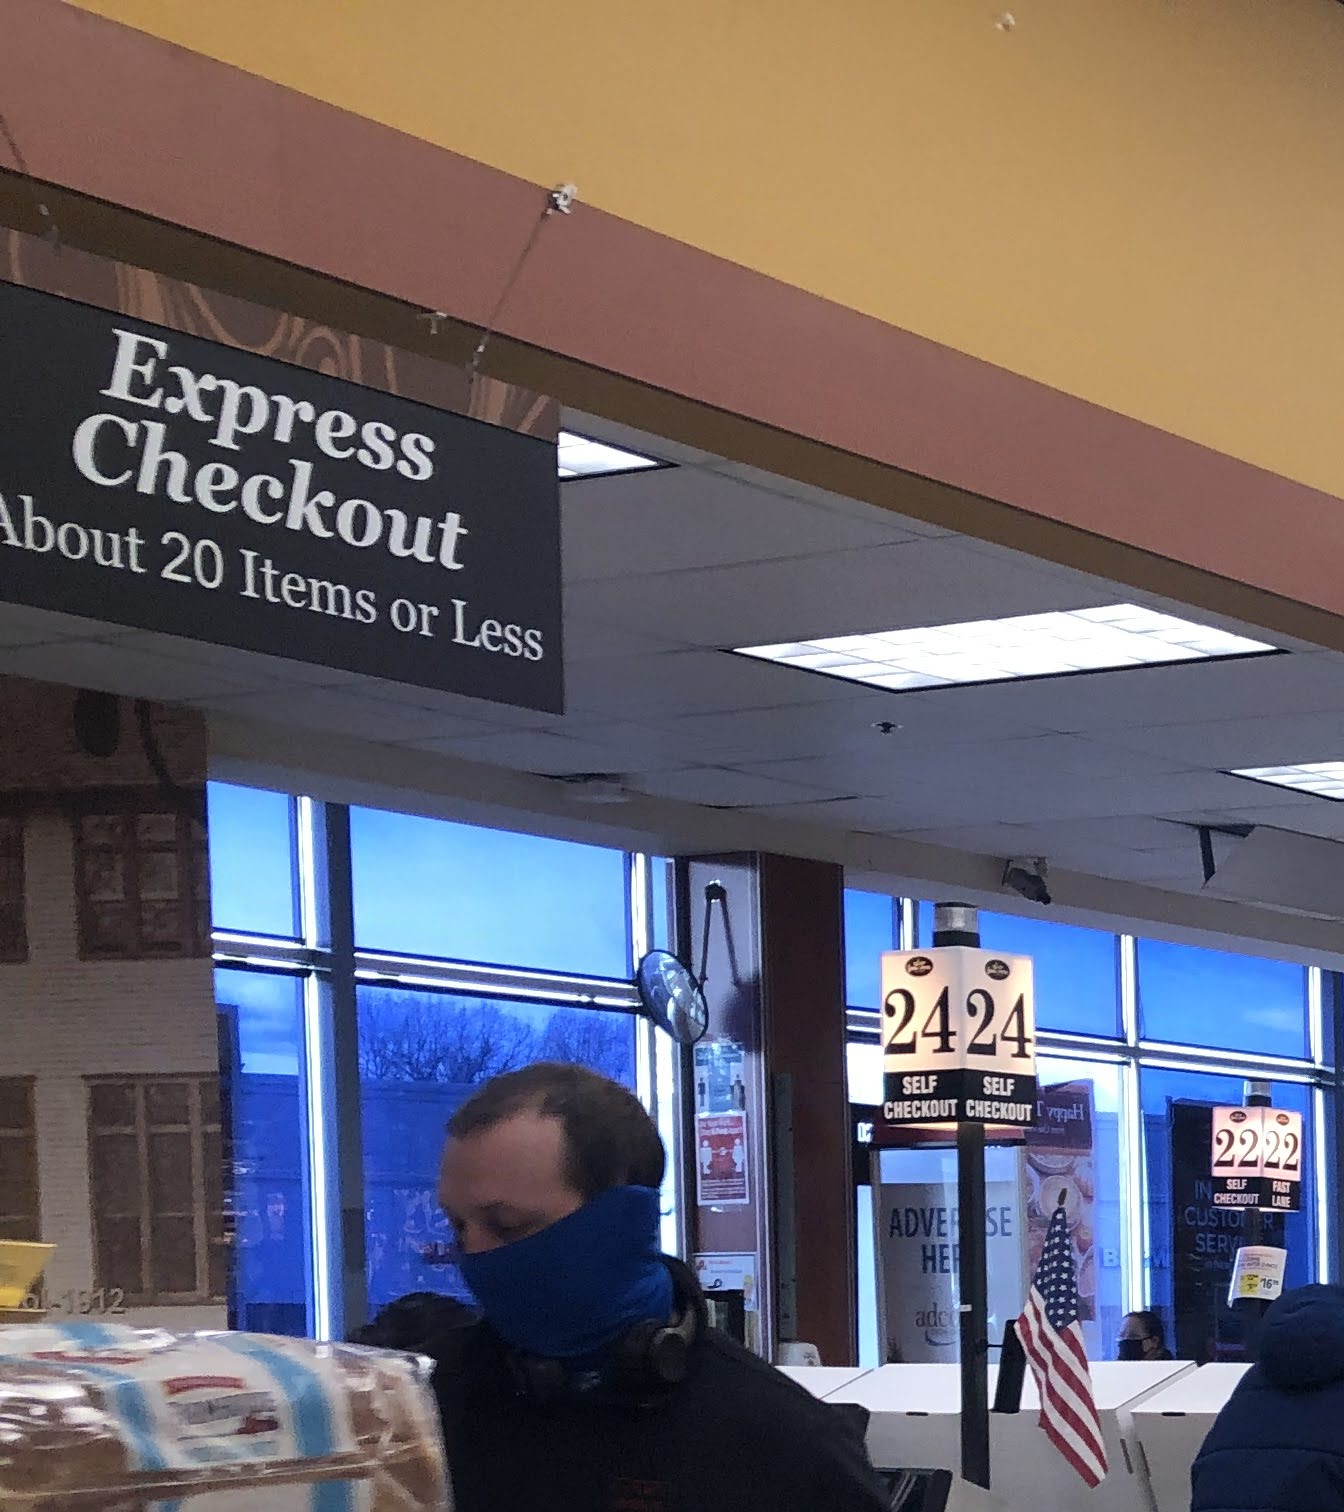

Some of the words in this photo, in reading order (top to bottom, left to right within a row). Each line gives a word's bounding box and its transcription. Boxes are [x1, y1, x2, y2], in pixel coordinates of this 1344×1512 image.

[100, 328, 436, 481] Express
[72, 412, 468, 571] Checkout
[0, 495, 146, 574] About
[160, 530, 223, 589] 20
[240, 549, 378, 624] Items
[389, 598, 440, 637] or
[452, 599, 544, 662] Less
[884, 986, 957, 1055] 24
[966, 988, 1032, 1059] 24
[902, 1075, 938, 1095] SELF
[983, 1076, 1015, 1096] SELF
[884, 1099, 958, 1120] CHECKOUT
[966, 1099, 1032, 1121] CHECKOUT
[1214, 1128, 1260, 1168] 22
[1264, 1130, 1299, 1171] 22
[1226, 1178, 1248, 1191] SELF
[1272, 1181, 1291, 1194] FAST
[1213, 1192, 1260, 1205] CHECKOUT
[1271, 1194, 1291, 1208] LANE
[1184, 1206, 1273, 1230] CUSTOR
